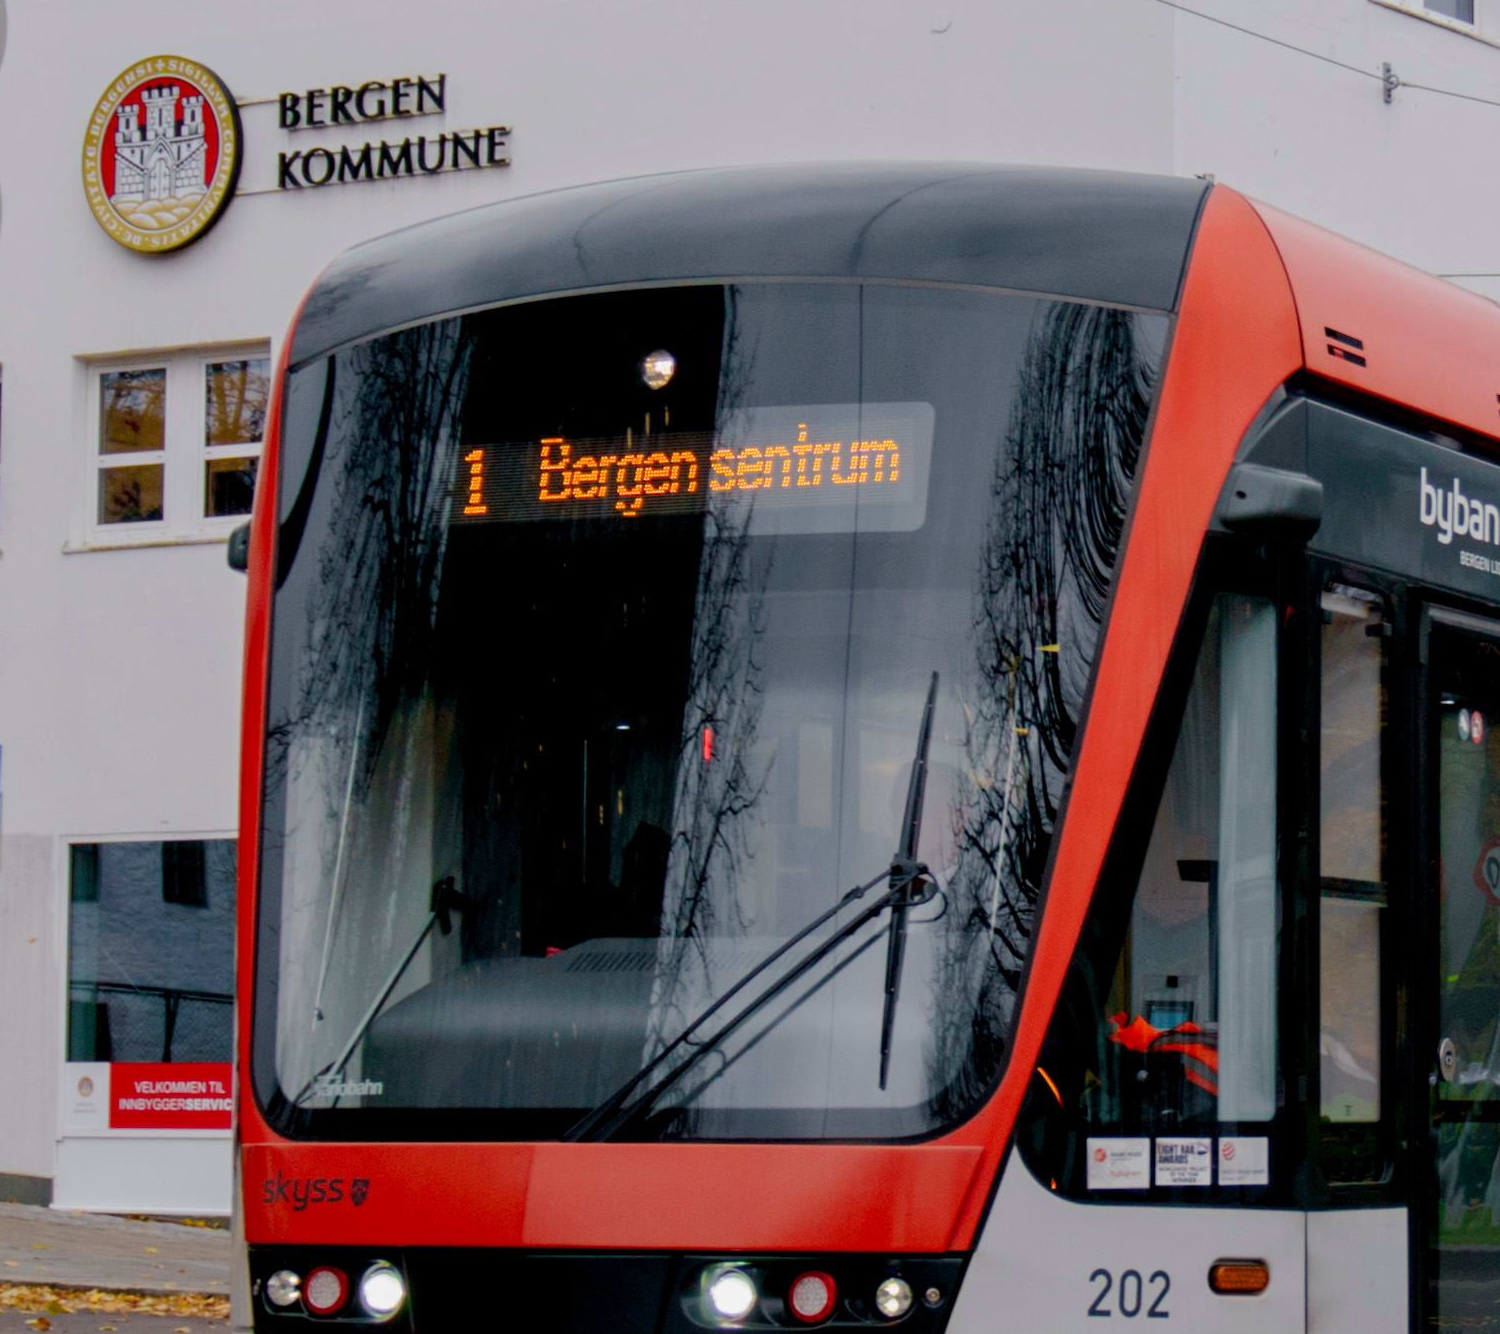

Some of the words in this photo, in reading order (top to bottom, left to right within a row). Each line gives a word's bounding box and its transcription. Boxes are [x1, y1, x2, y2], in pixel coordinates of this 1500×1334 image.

[279, 74, 446, 129] BERGEN
[278, 127, 511, 189] KOMMUNE
[464, 449, 488, 515] 1
[539, 438, 698, 517] Bergen
[709, 423, 899, 492] sentrum
[1460, 551, 1490, 572] BERGEN
[119, 1098, 232, 1111] INNBYGGERSERVIC
[134, 1081, 203, 1094] VELKOMMEN
[206, 1081, 226, 1094] TIL
[264, 1171, 344, 1211] skyss
[1087, 1268, 1171, 1318] 202
